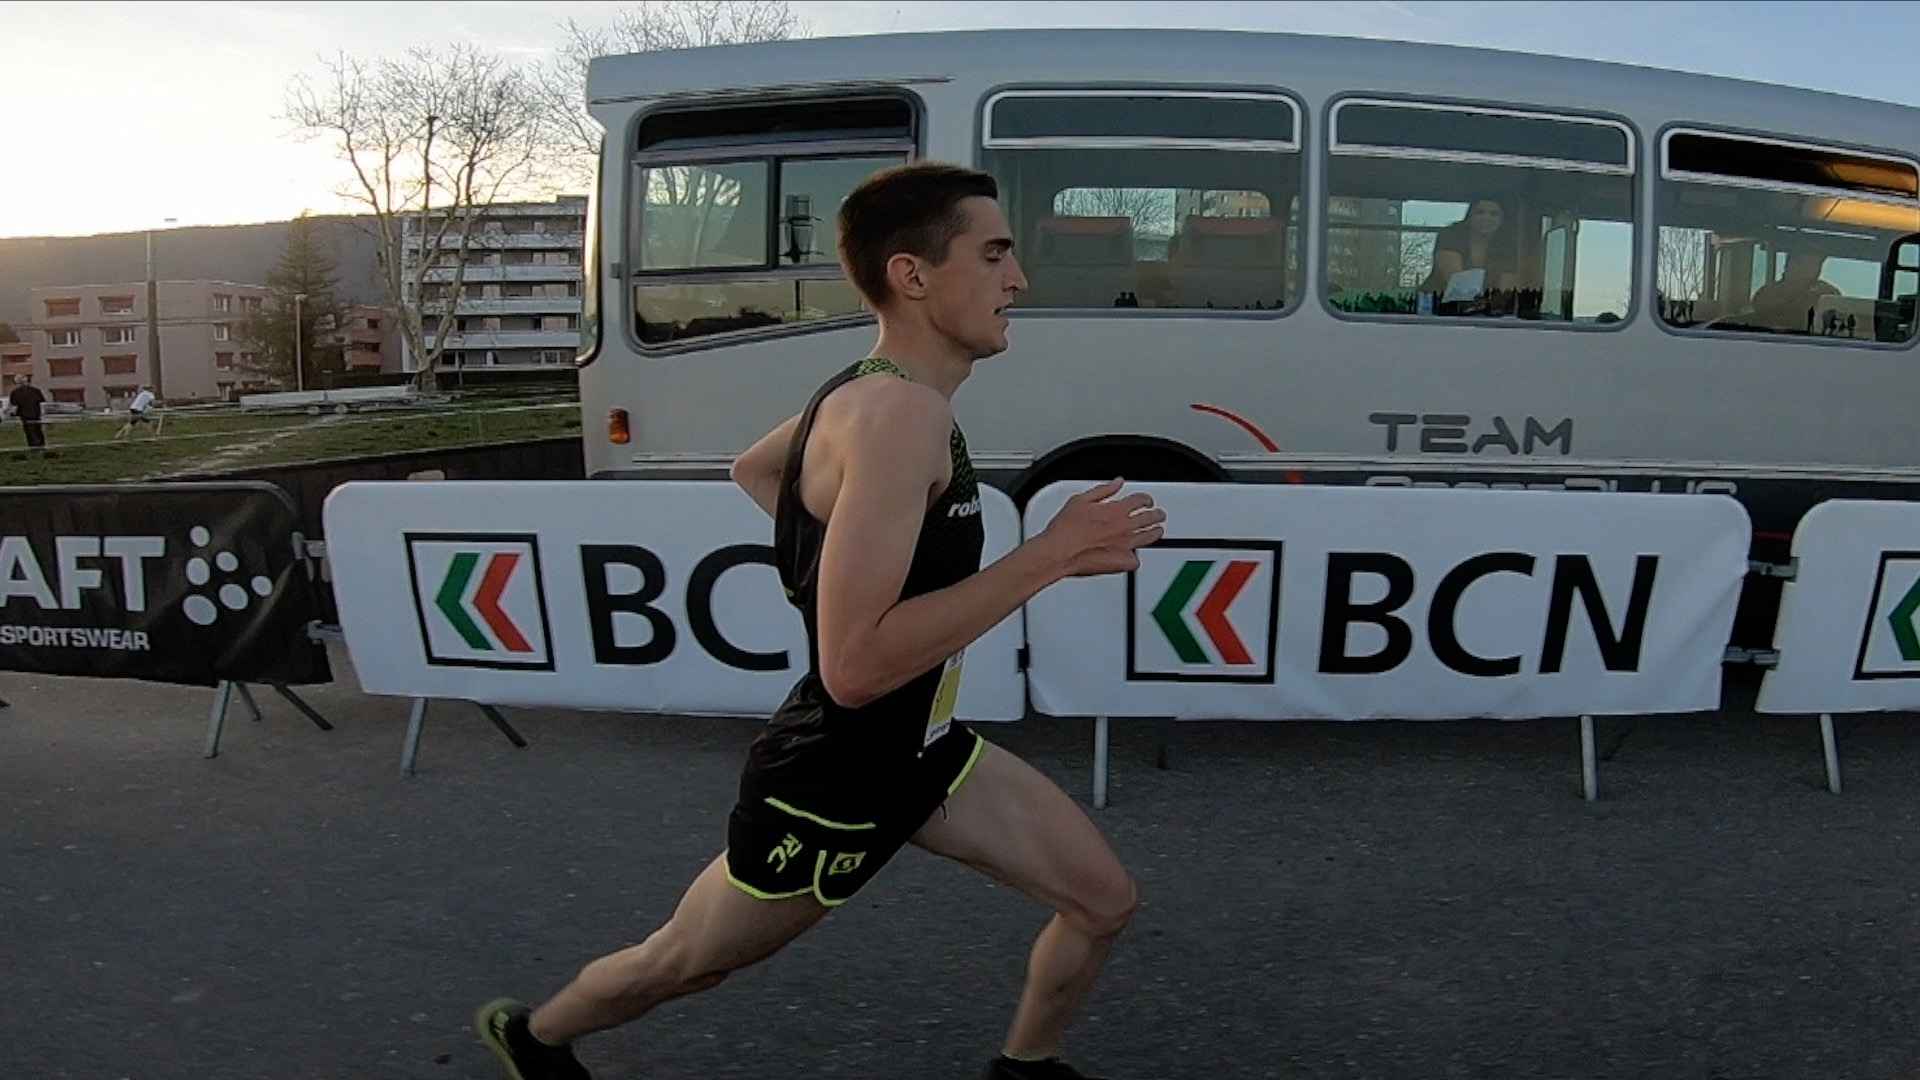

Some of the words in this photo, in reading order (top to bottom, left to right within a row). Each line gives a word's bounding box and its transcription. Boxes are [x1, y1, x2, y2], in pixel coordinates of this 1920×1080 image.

[1369, 412, 1573, 455] TEAM
[0, 625, 150, 651] SPORTSWEAR
[580, 543, 791, 672] BC
[1317, 551, 1661, 677] BCN
